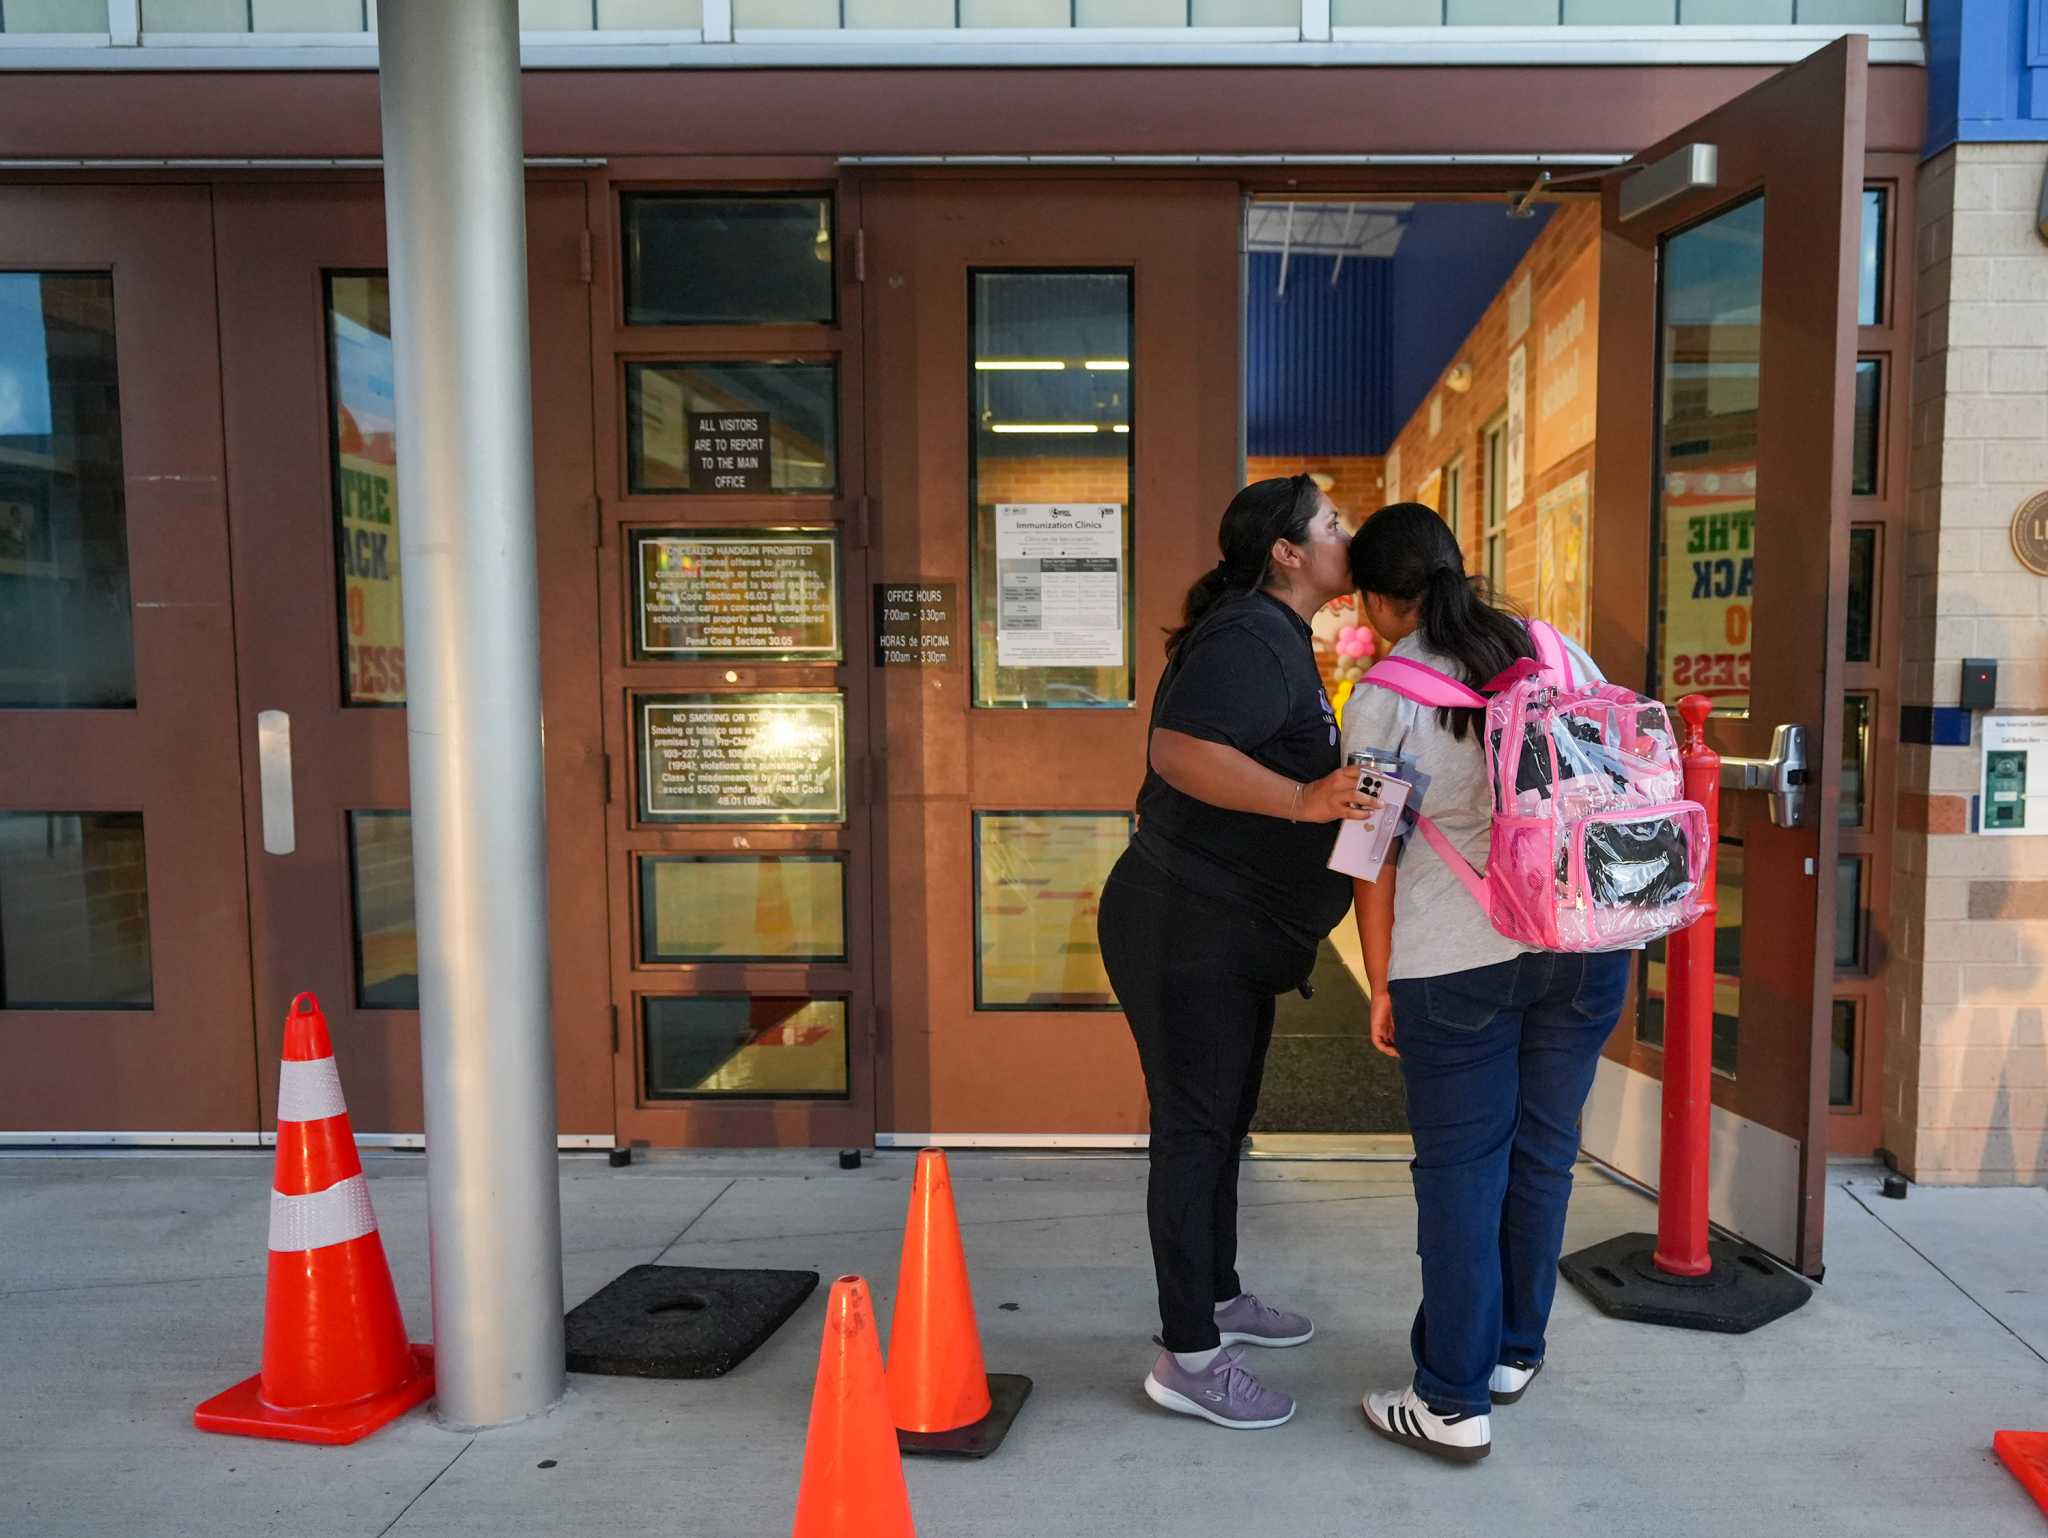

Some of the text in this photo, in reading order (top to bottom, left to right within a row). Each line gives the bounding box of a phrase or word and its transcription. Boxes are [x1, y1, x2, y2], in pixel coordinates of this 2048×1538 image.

[699, 418, 759, 432] ALL VISITORS
[694, 438, 764, 452] ARE TO REPORT
[701, 457, 760, 470] TO THE MAIN
[714, 476, 746, 489] OFFICE
[1016, 520, 1102, 530] Immunization Clinics
[2034, 519, 2048, 541] L
[664, 546, 813, 555] ONCEALED HANDGUN PROHIBITED
[731, 559, 761, 567] offense
[765, 559, 772, 567] to
[776, 560, 796, 569] carry
[751, 570, 777, 578] school
[649, 581, 657, 589] to
[732, 581, 747, 589] and
[681, 592, 702, 600] Code
[706, 592, 740, 600] Sections
[887, 590, 942, 602] OFFICE HOURS
[699, 604, 719, 613] carry
[731, 603, 772, 612] concealed
[653, 615, 824, 624] school-owned property will be considered
[704, 626, 734, 634] criminal
[686, 637, 793, 645] Penal Code Section 30.05
[880, 635, 949, 647] HORAS de OFICINA
[673, 713, 686, 722] NO
[689, 713, 729, 722] SMOKING
[733, 713, 745, 722] OR
[651, 726, 683, 736] Smoking
[696, 726, 727, 735] tobacco
[655, 738, 688, 747] premises
[691, 738, 699, 747] by
[703, 738, 714, 746] the
[703, 749, 725, 759] 1043,
[700, 761, 740, 770] violations
[662, 773, 685, 782] Class
[688, 773, 695, 782] C
[663, 785, 694, 794] exceed
[697, 785, 720, 794] $500
[722, 785, 746, 794] under
[801, 785, 824, 795] Code
